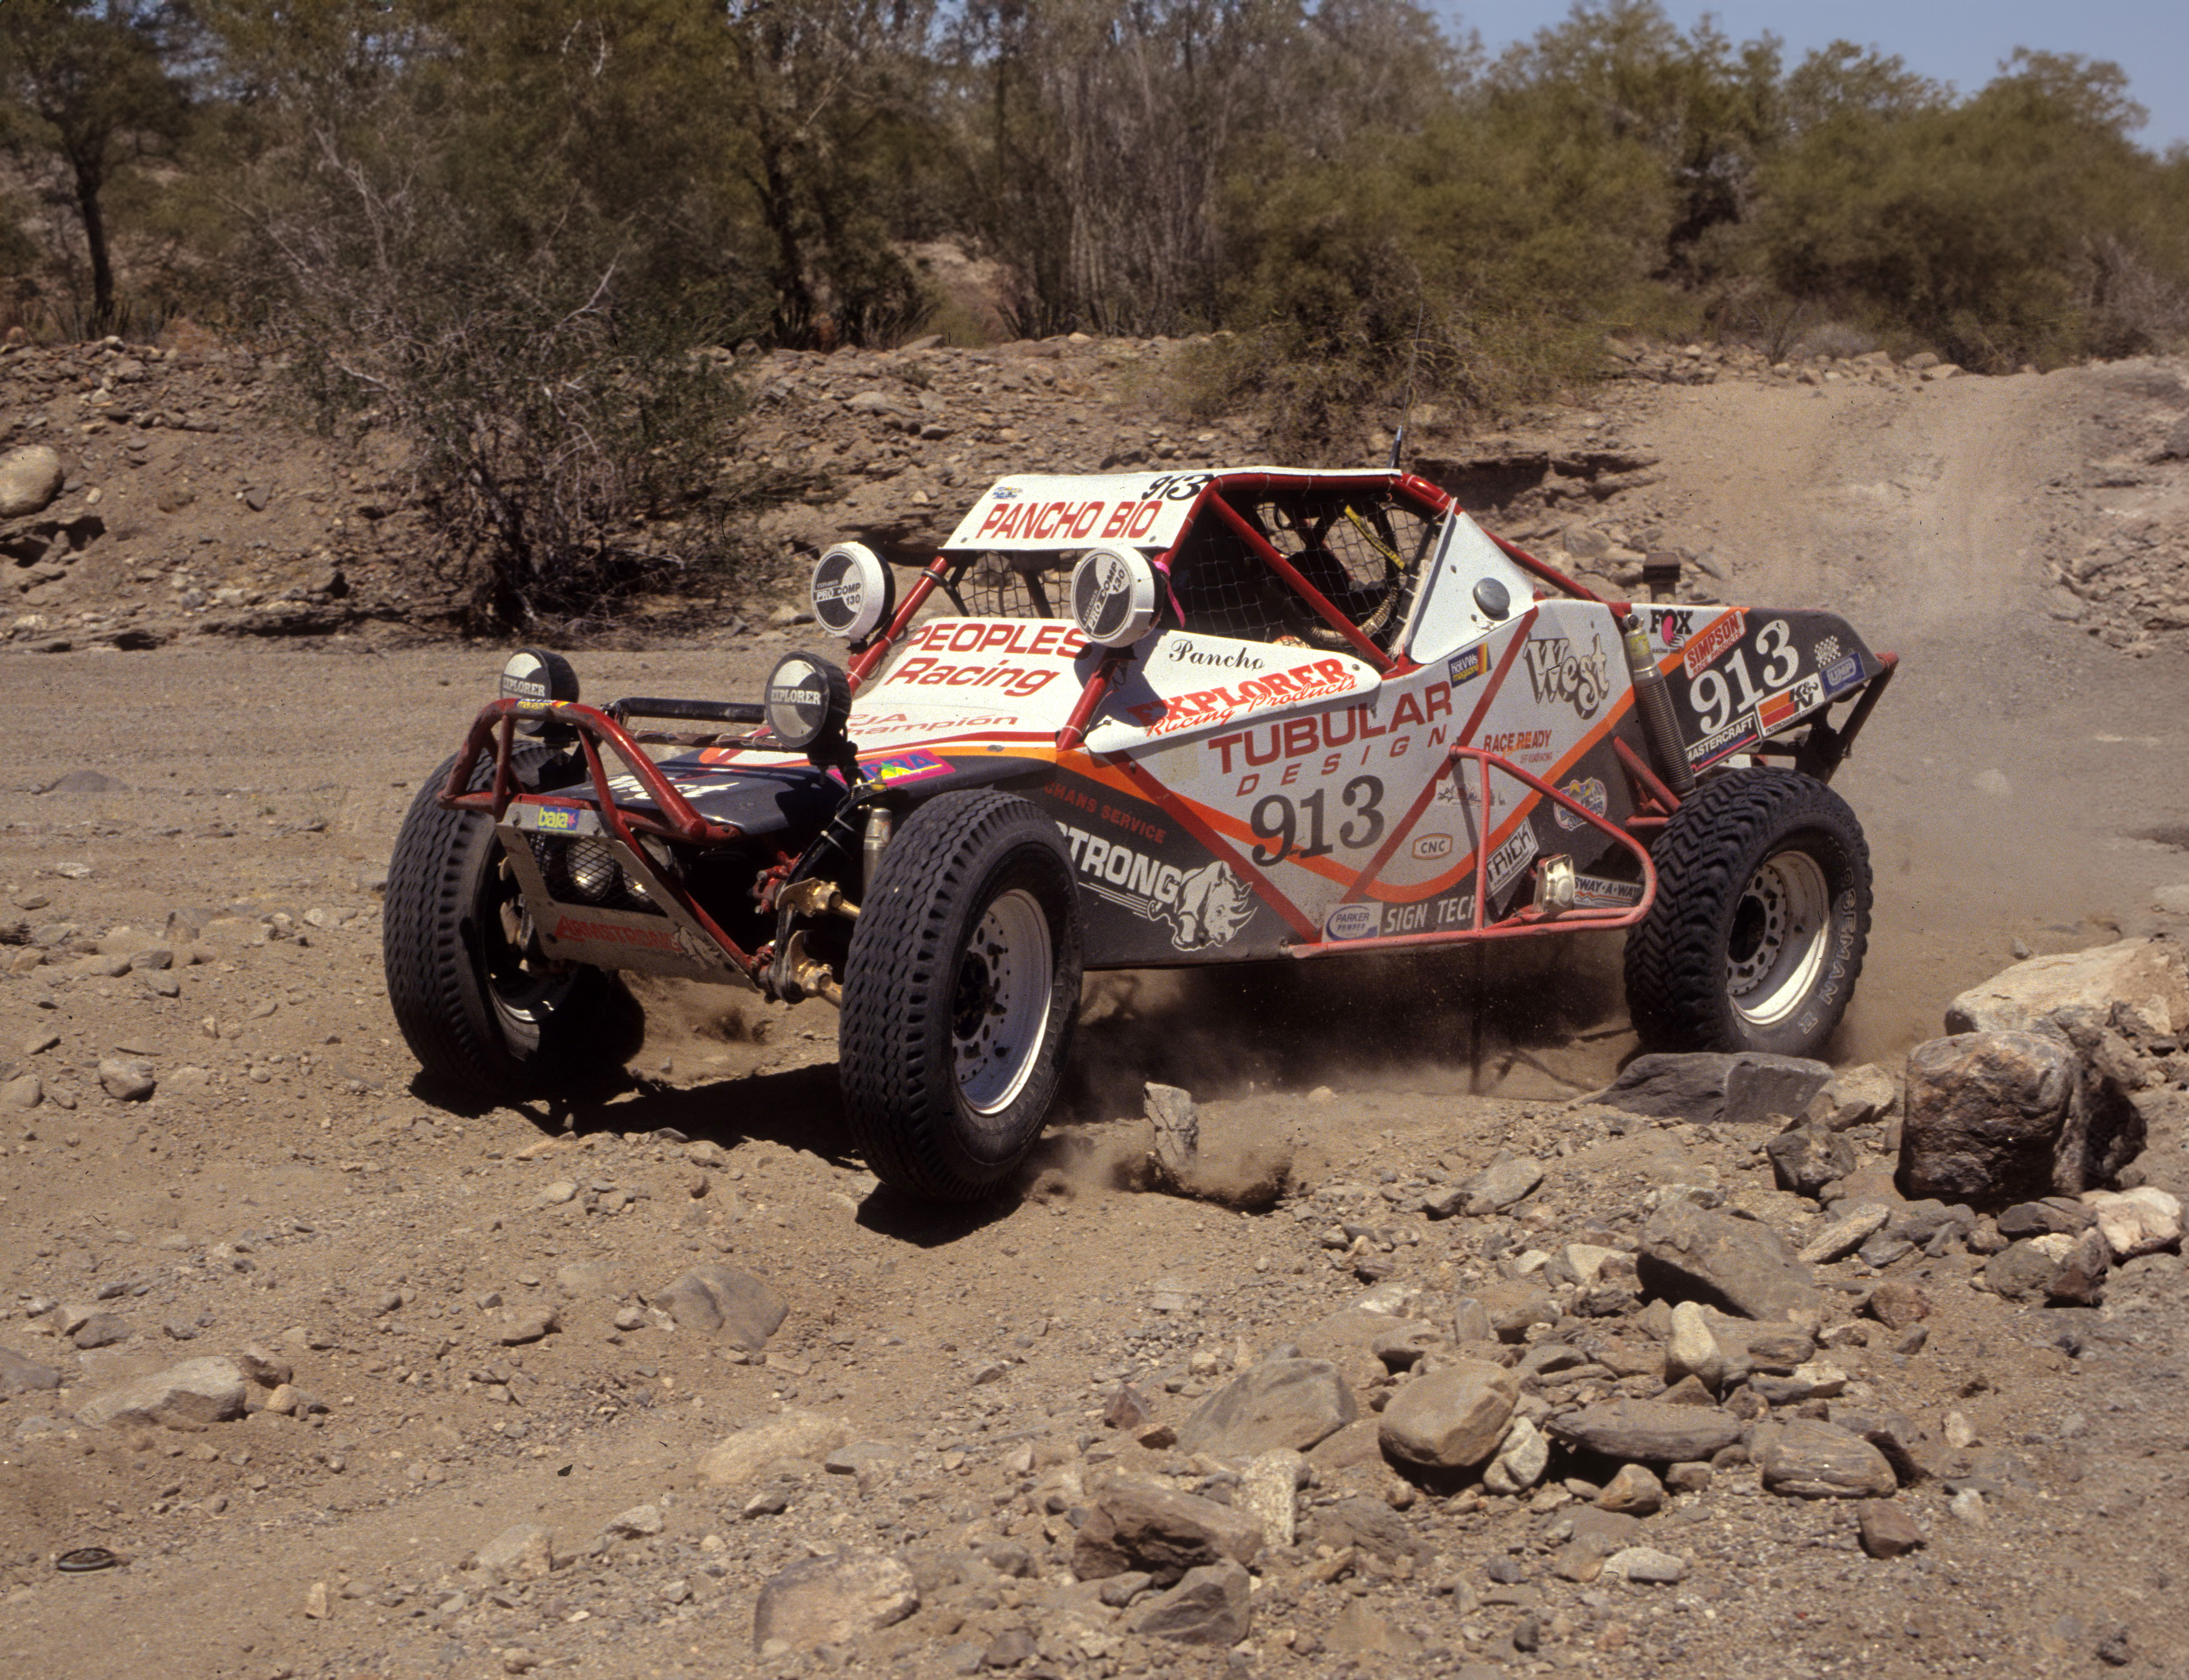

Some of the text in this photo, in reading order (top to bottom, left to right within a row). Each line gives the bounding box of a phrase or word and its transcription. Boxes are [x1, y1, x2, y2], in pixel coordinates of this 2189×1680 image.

[1142, 474, 1214, 500] 913
[975, 501, 1163, 539] PANCHO BIO
[817, 583, 861, 600] PRO COMP
[1088, 561, 1116, 627] PRO COMP
[1113, 569, 1125, 592] 130
[846, 594, 861, 605] 130
[1650, 609, 1694, 635] FOX
[905, 623, 1093, 660] PEOPLES
[1169, 639, 1265, 670] Pancho
[1687, 615, 1740, 669] SIMPSON
[884, 657, 1060, 697] Racing
[1125, 658, 1350, 727] EXPLORER
[1523, 633, 1609, 720] West
[1690, 619, 1799, 734] 913
[772, 689, 821, 705] EXPLORER
[1147, 674, 1358, 737] Racing Products
[1789, 681, 1819, 712] K&N
[1208, 680, 1453, 774] TUBULAR
[1484, 729, 1552, 752] RACE READY
[1236, 724, 1447, 797] DESIGN
[1101, 805, 1167, 844] SERVICE
[1250, 775, 1384, 867] 913
[1056, 821, 1182, 904] TRONG
[1421, 840, 1445, 854] CNC
[1336, 913, 1369, 923] PARKER
[1384, 902, 1428, 934] SIGN
